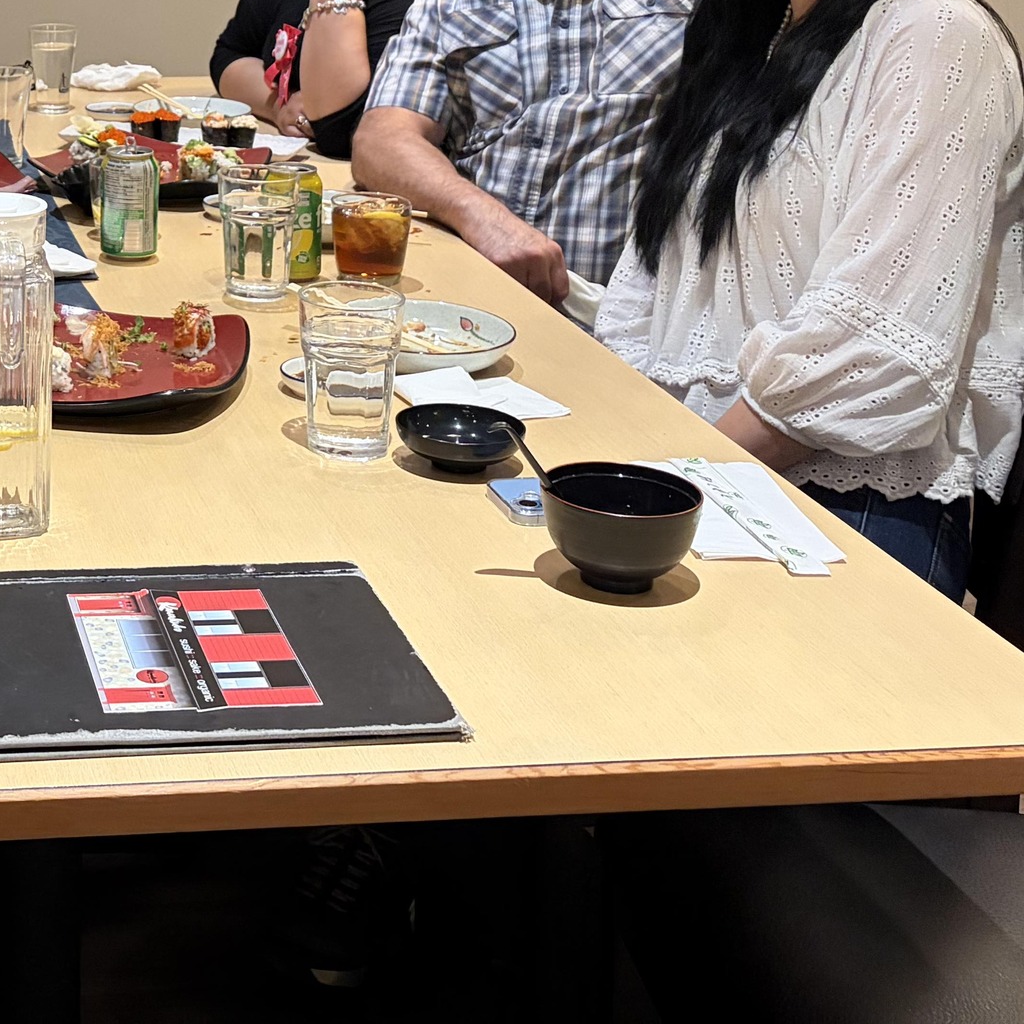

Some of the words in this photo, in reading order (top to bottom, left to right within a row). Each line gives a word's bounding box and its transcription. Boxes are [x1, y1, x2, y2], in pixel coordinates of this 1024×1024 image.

[179, 638, 196, 655] sushi
[188, 659, 202, 675] sake
[196, 679, 216, 703] organic
